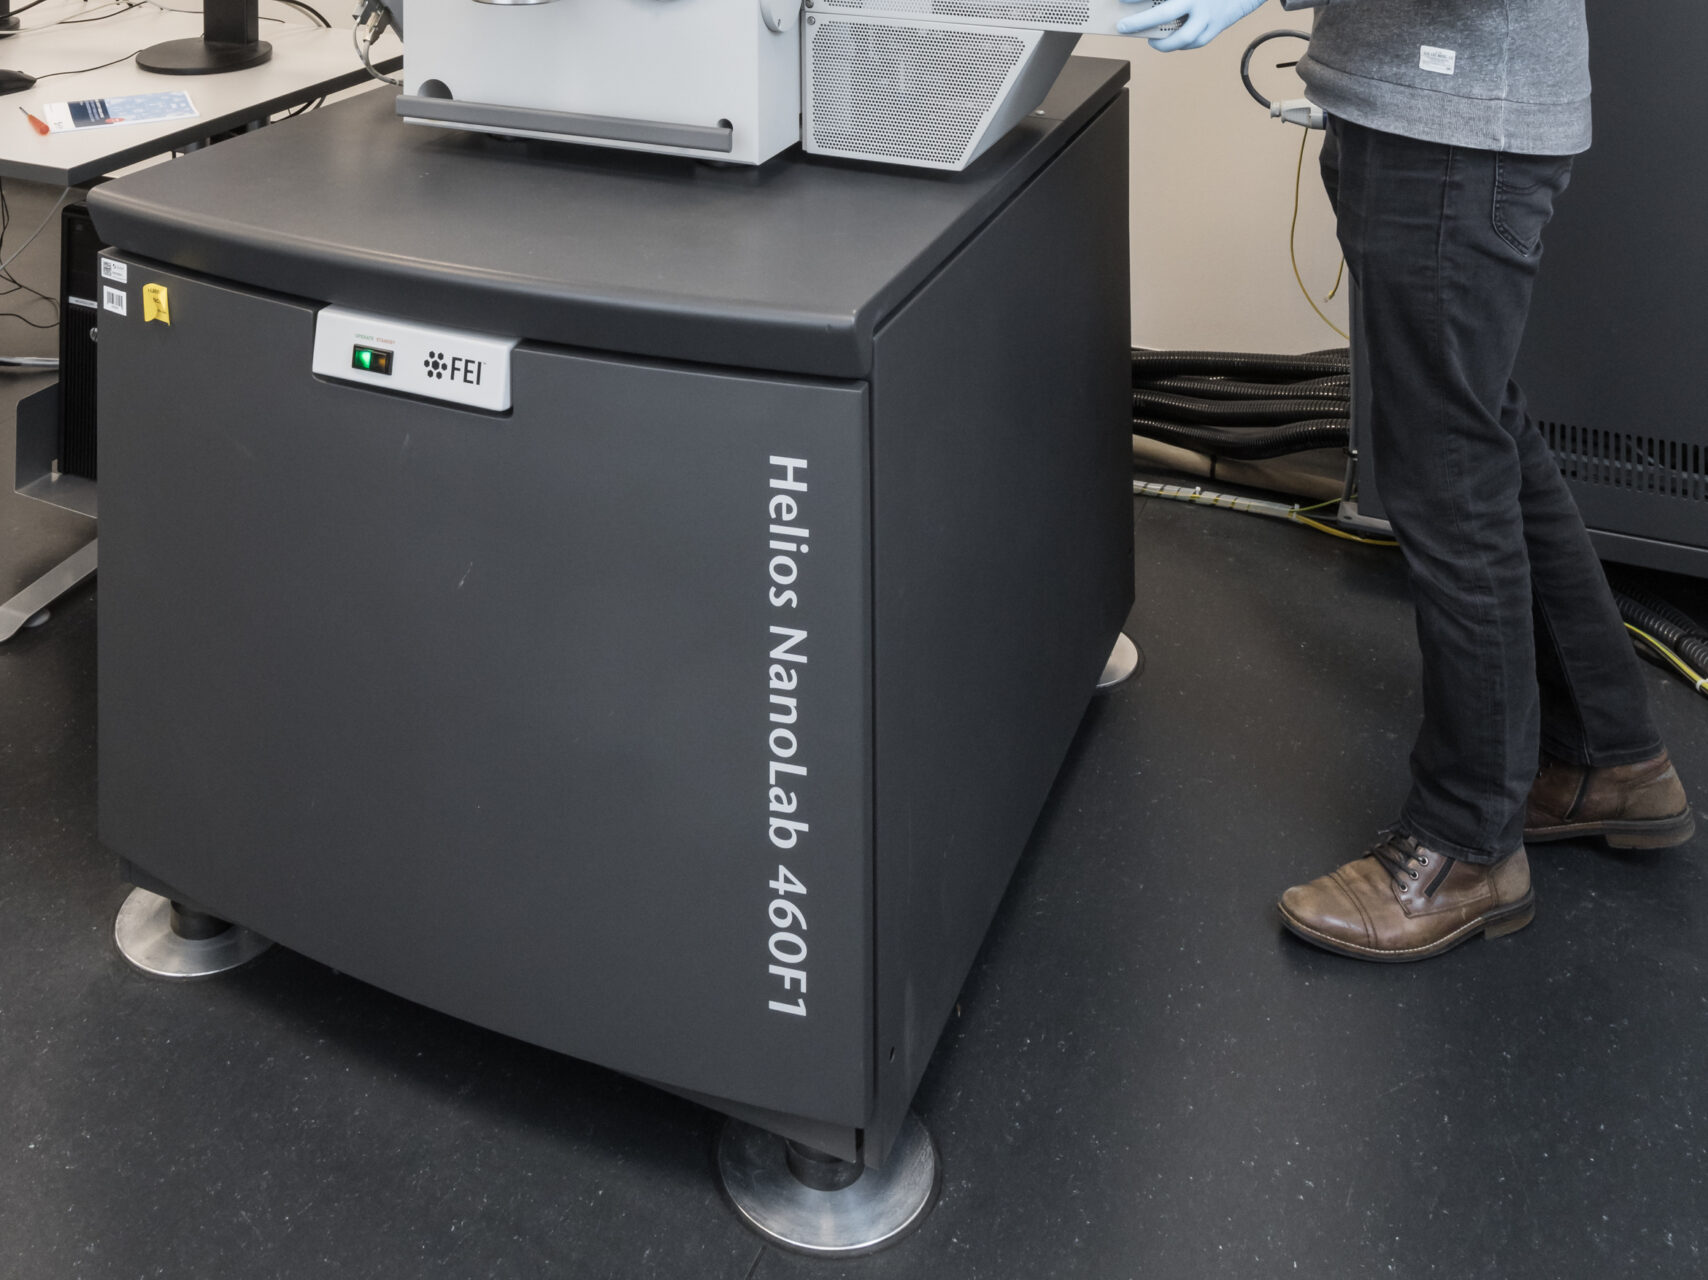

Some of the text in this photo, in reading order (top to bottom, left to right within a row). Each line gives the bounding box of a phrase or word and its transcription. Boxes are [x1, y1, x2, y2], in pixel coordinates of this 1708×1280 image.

[767, 454, 810, 1016] Helios NanoLab 460F1
